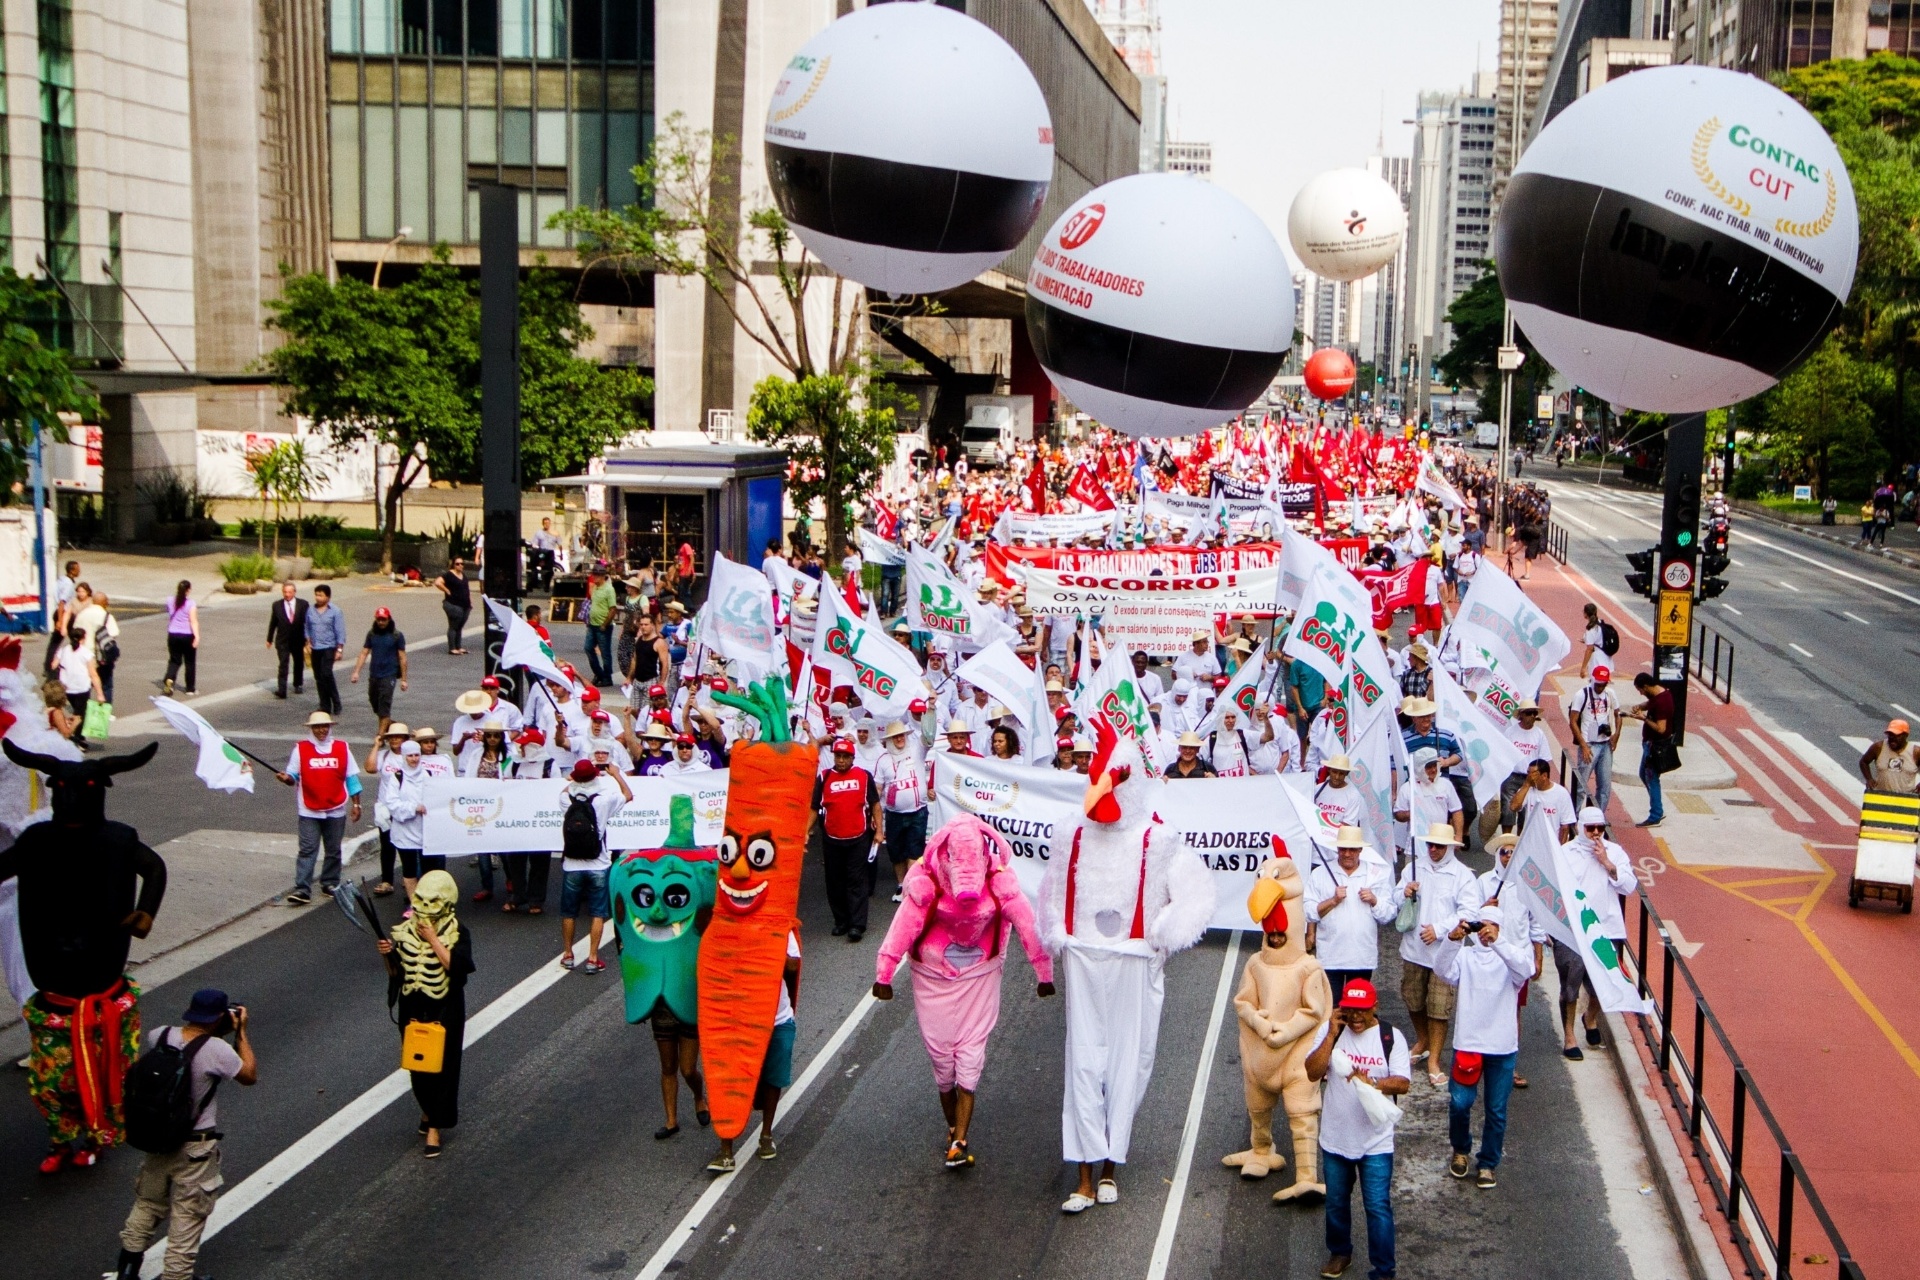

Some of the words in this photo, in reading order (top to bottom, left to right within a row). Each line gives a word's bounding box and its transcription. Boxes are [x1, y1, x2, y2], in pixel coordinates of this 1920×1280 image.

[1728, 124, 1819, 183] CONTAC
[1749, 168, 1794, 202] CUT
[1664, 189, 1696, 211] CONF.
[1700, 203, 1724, 221] NAC
[1726, 214, 1751, 234] TRAB.
[1754, 227, 1771, 244] IND.
[1773, 237, 1824, 274] ALIMENTAÇÃO
[1055, 255, 1145, 297] TRABALHADORES
[1034, 271, 1093, 309] ALIMENTAÇÃO
[1213, 471, 1243, 488] CHEGA
[1245, 482, 1259, 491] DE
[1167, 499, 1184, 507] Paga
[1059, 554, 1075, 572] OS
[1078, 553, 1174, 576] TRABALHADORES
[1177, 553, 1191, 575] DA
[1196, 552, 1216, 573] JBS
[1221, 551, 1235, 572] DE
[1239, 550, 1268, 570] MATO
[1057, 574, 1219, 591] SOCORRO
[1053, 592, 1079, 601] OS
[1031, 605, 1081, 614] SANTA
[1236, 602, 1287, 612] AJUDA
[1113, 605, 1118, 615] O
[1140, 605, 1156, 615] rural
[1107, 624, 1114, 633] de
[1127, 623, 1148, 633] salário
[1150, 624, 1174, 636] injusto
[1175, 627, 1193, 638] pago
[1178, 641, 1187, 650] de
[1514, 741, 1538, 750] CONTAC
[309, 757, 339, 769] CUT
[830, 779, 860, 794] CUT
[965, 776, 1009, 792] CONTAC
[458, 796, 495, 805] CONTAC
[698, 790, 727, 799] CONTA
[975, 791, 995, 802] CUT
[468, 806, 485, 814] CUT
[1318, 802, 1345, 813] CONTAC
[623, 810, 660, 818] PRIMEIRA
[495, 817, 530, 828] SALÁRIO
[532, 820, 537, 828] E
[608, 819, 645, 828] RABALHO
